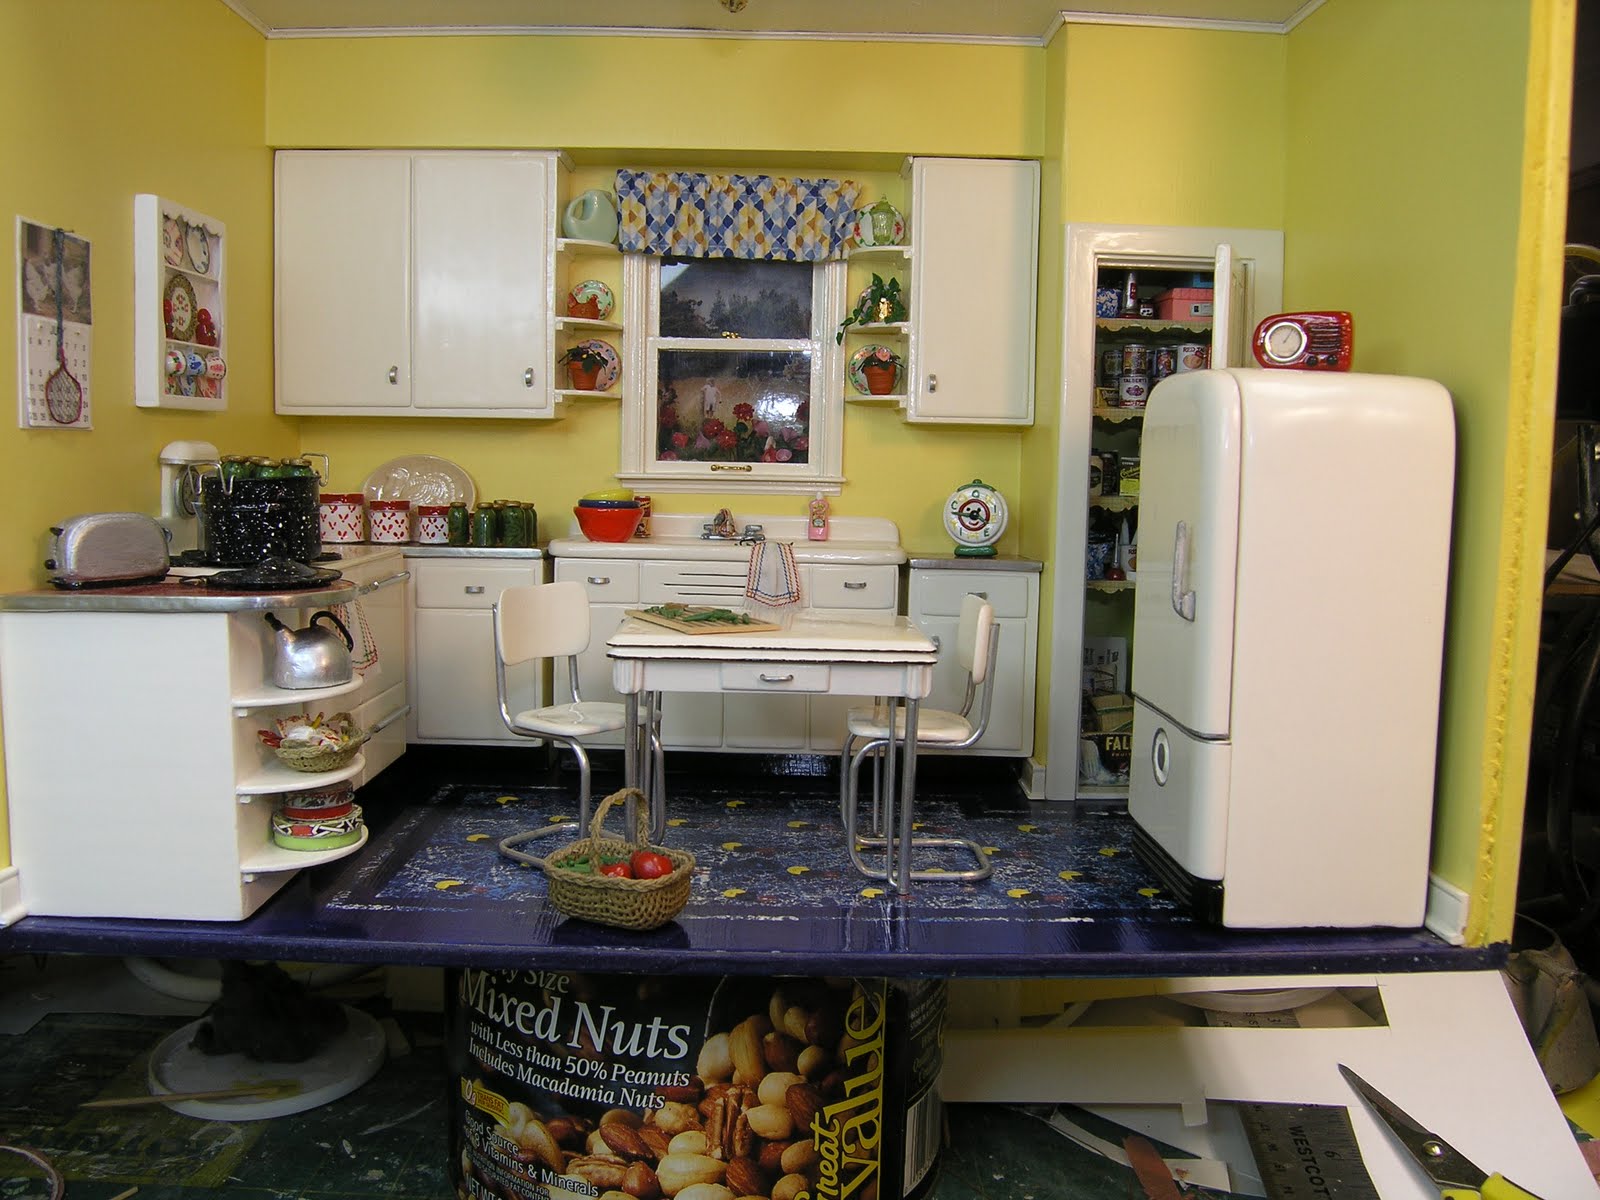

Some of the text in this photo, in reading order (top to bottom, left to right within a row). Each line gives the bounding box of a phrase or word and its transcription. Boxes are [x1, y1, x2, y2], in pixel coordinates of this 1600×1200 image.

[461, 967, 691, 1060] Mixed Nuts
[468, 1036, 666, 1110] Includes Macadamia Nuts
[470, 1020, 691, 1088] with Less than 50% Peanuts
[464, 1109, 520, 1157] Good Source
[481, 1137, 525, 1175] Vitamins
[527, 1164, 538, 1180] &
[541, 1168, 600, 1198] Minerals
[1288, 1125, 1334, 1200] WESTCOT
